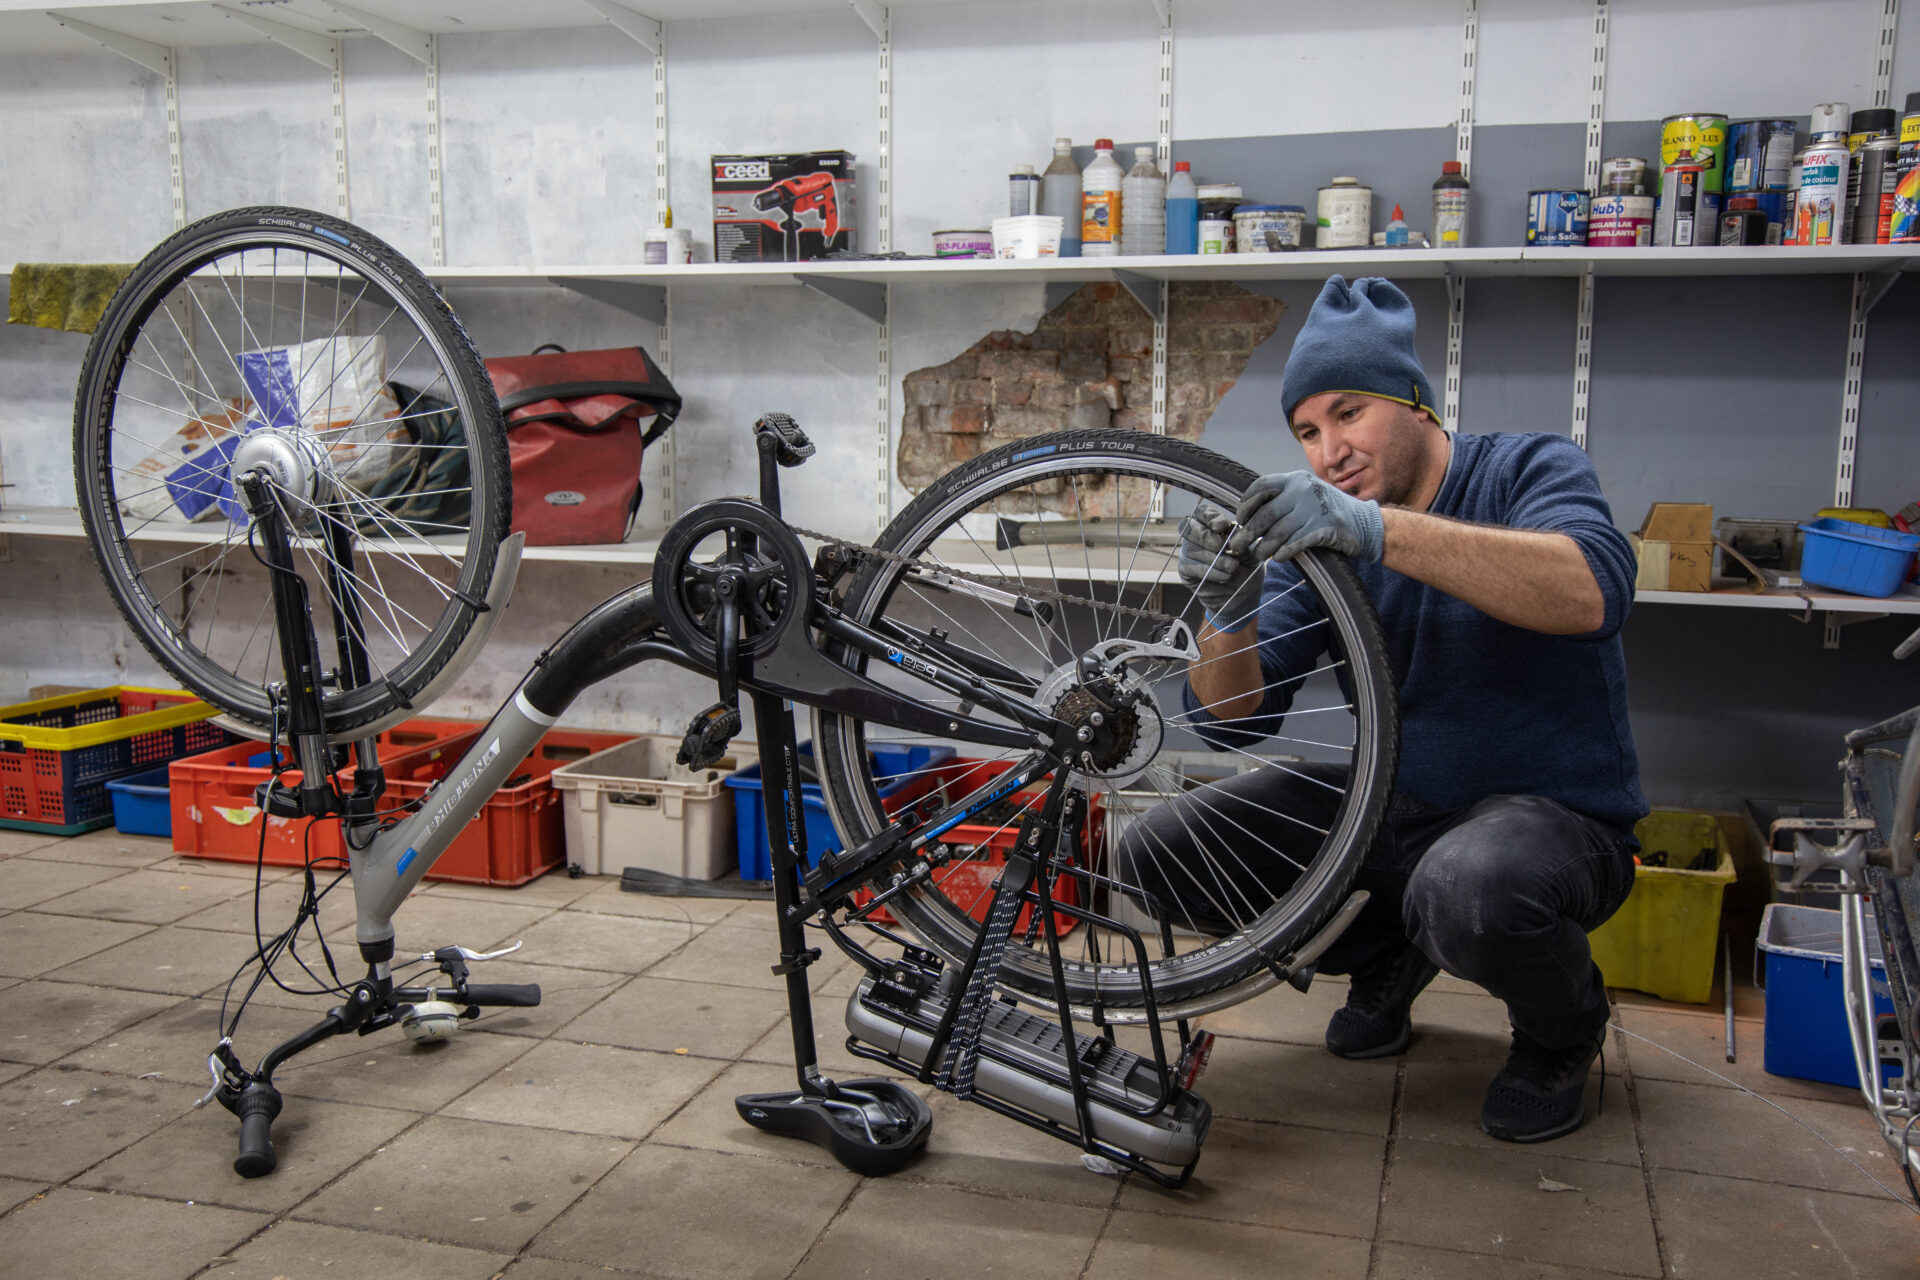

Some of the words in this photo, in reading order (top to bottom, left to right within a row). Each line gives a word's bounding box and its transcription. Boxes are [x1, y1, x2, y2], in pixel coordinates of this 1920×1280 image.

[1663, 135, 1696, 146] BLANCO
[1702, 134, 1719, 143] LUX
[1811, 175, 1836, 184] couleur
[1592, 203, 1624, 215] Hubo
[258, 217, 313, 231] SCHWALBE
[350, 243, 377, 262] PLUS
[379, 262, 404, 284] TOUR
[947, 457, 1008, 495] SCHWALBE
[1059, 441, 1095, 452] PLUS
[1100, 441, 1135, 452] TOUR
[903, 655, 938, 679] beta
